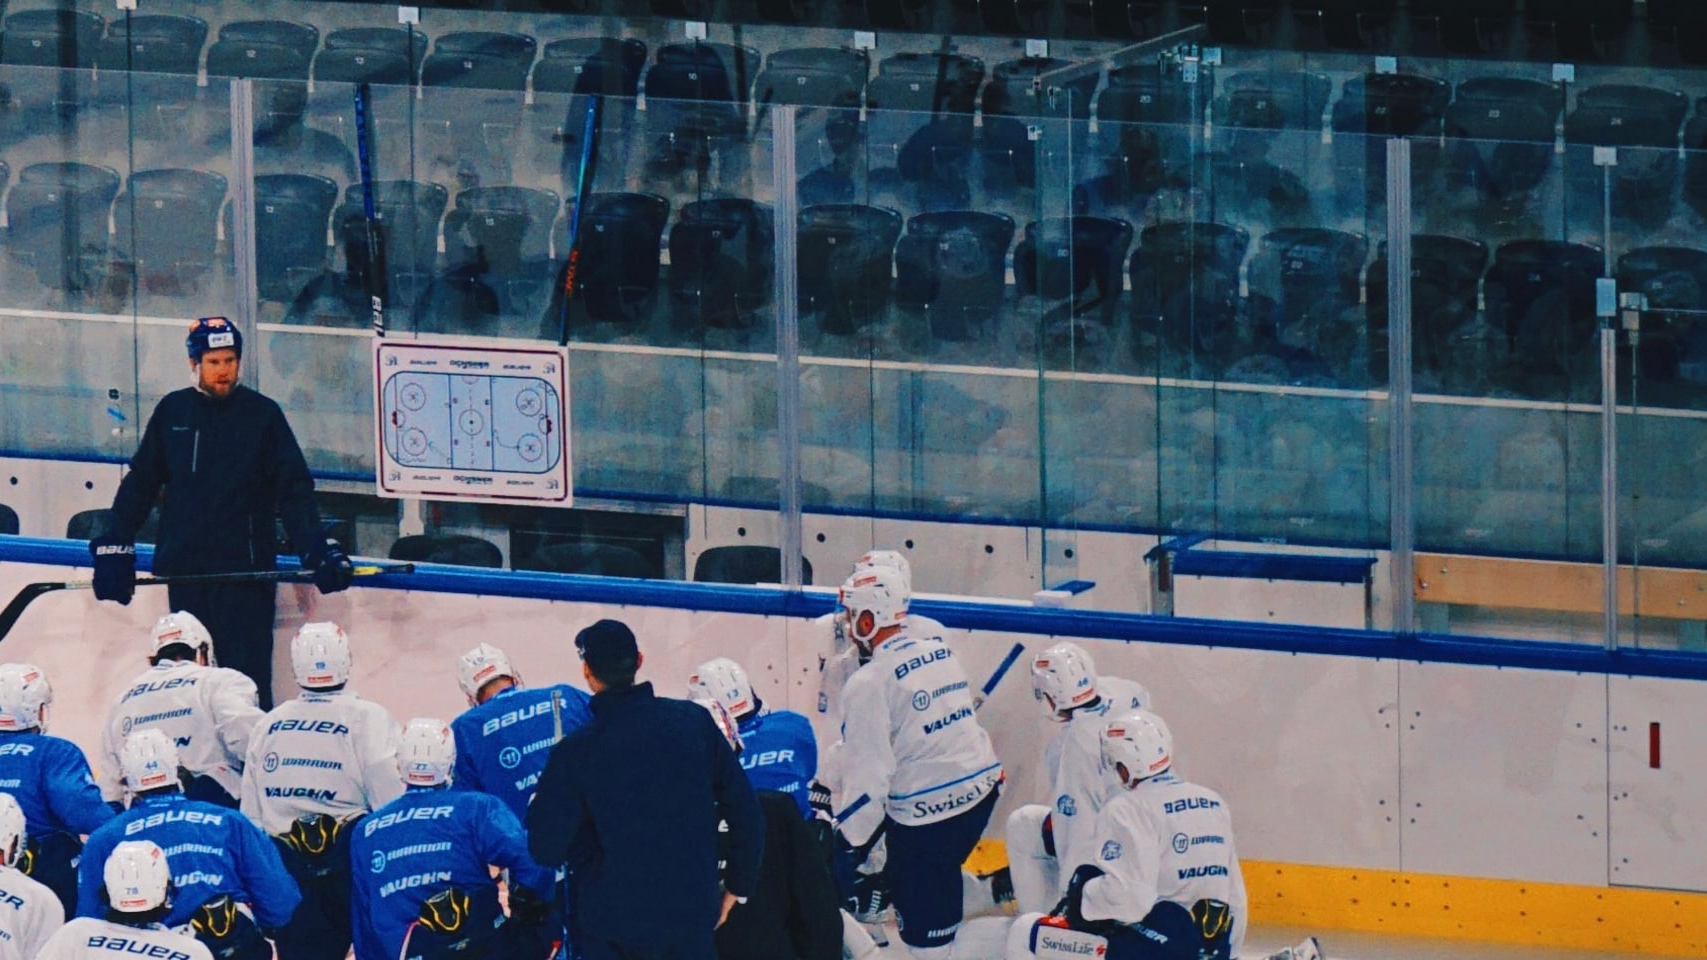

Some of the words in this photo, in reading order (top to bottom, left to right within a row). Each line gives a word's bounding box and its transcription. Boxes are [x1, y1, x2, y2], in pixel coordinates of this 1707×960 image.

[96, 545, 135, 555] BAUE
[121, 677, 198, 704] BAUER
[267, 719, 350, 736] BAUER
[281, 757, 343, 771] WARRIOR
[739, 749, 795, 770] UER
[264, 786, 338, 801] VAUGHN
[1163, 796, 1221, 814] BAUER
[125, 810, 223, 836] BAUER
[364, 804, 455, 838] BAUER
[174, 870, 223, 888] UGHN
[380, 870, 452, 898] VAUGHN
[1041, 936, 1094, 956] SwissLife
